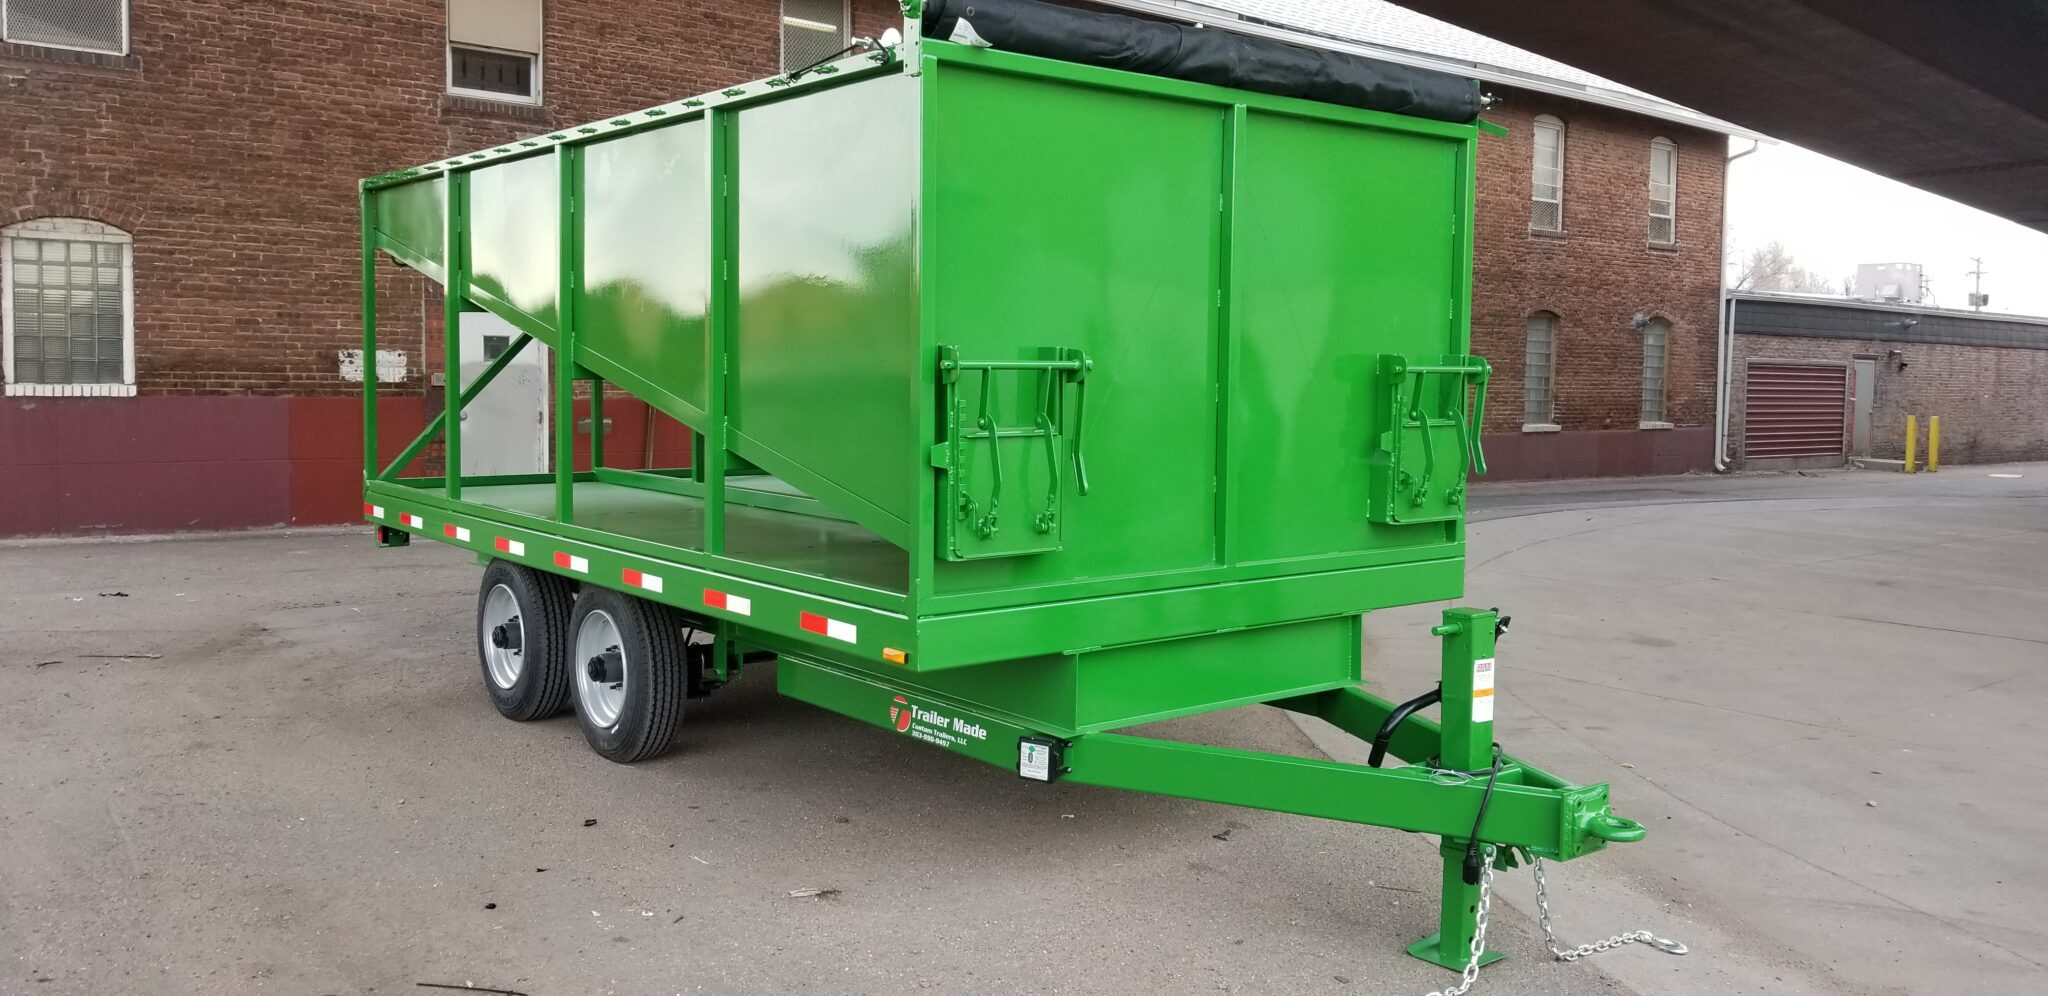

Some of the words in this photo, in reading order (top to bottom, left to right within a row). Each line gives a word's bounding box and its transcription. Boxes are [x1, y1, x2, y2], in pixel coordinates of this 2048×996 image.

[911, 704, 950, 728] Trailer
[952, 717, 987, 740] Made
[911, 722, 933, 735] Custom
[957, 736, 968, 746] LLC
